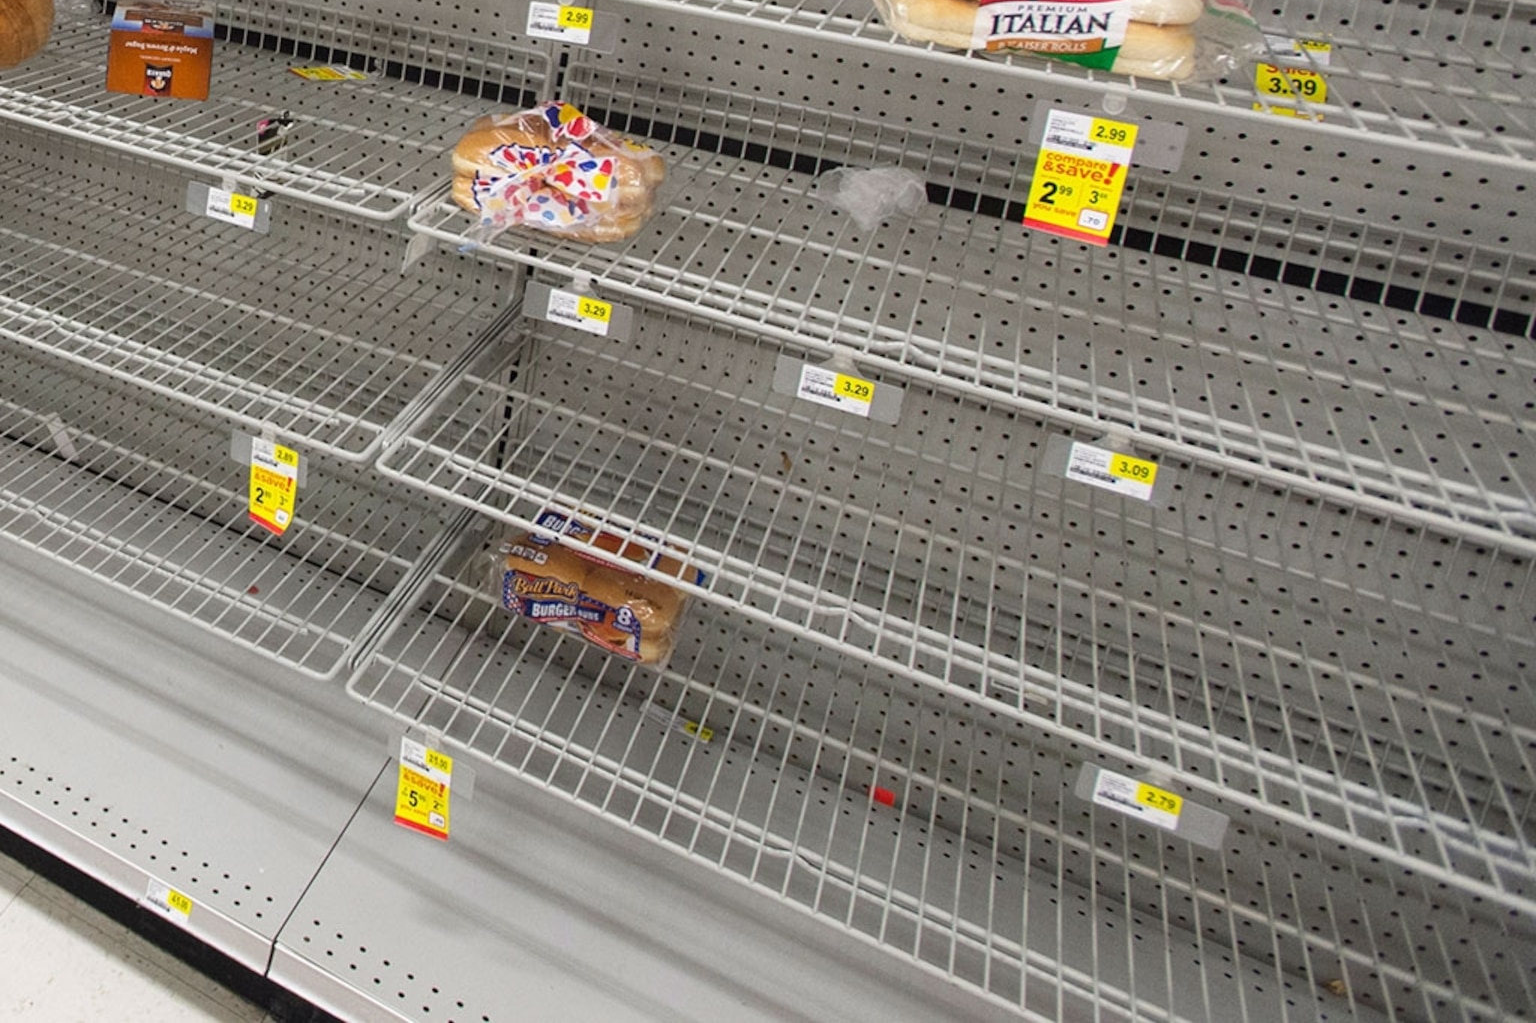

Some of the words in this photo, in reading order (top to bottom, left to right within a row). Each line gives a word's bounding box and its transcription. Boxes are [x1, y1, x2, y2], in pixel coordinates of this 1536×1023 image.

[1017, 4, 1088, 13] PREMIUM
[566, 11, 590, 25] 2.99
[989, 10, 1116, 36] ITALIAN
[1051, 41, 1088, 52] ROLLS
[1096, 125, 1127, 142] 2.99
[1046, 152, 1108, 172] compare
[1052, 207, 1077, 218] save
[583, 301, 607, 318] 3.29
[843, 380, 870, 398] 3.29
[1119, 461, 1150, 479] 3.09
[514, 577, 544, 595] Ball
[544, 578, 579, 598] Park
[531, 602, 577, 619] BURGER
[616, 607, 632, 626] 8
[1145, 790, 1177, 810] 2.79
